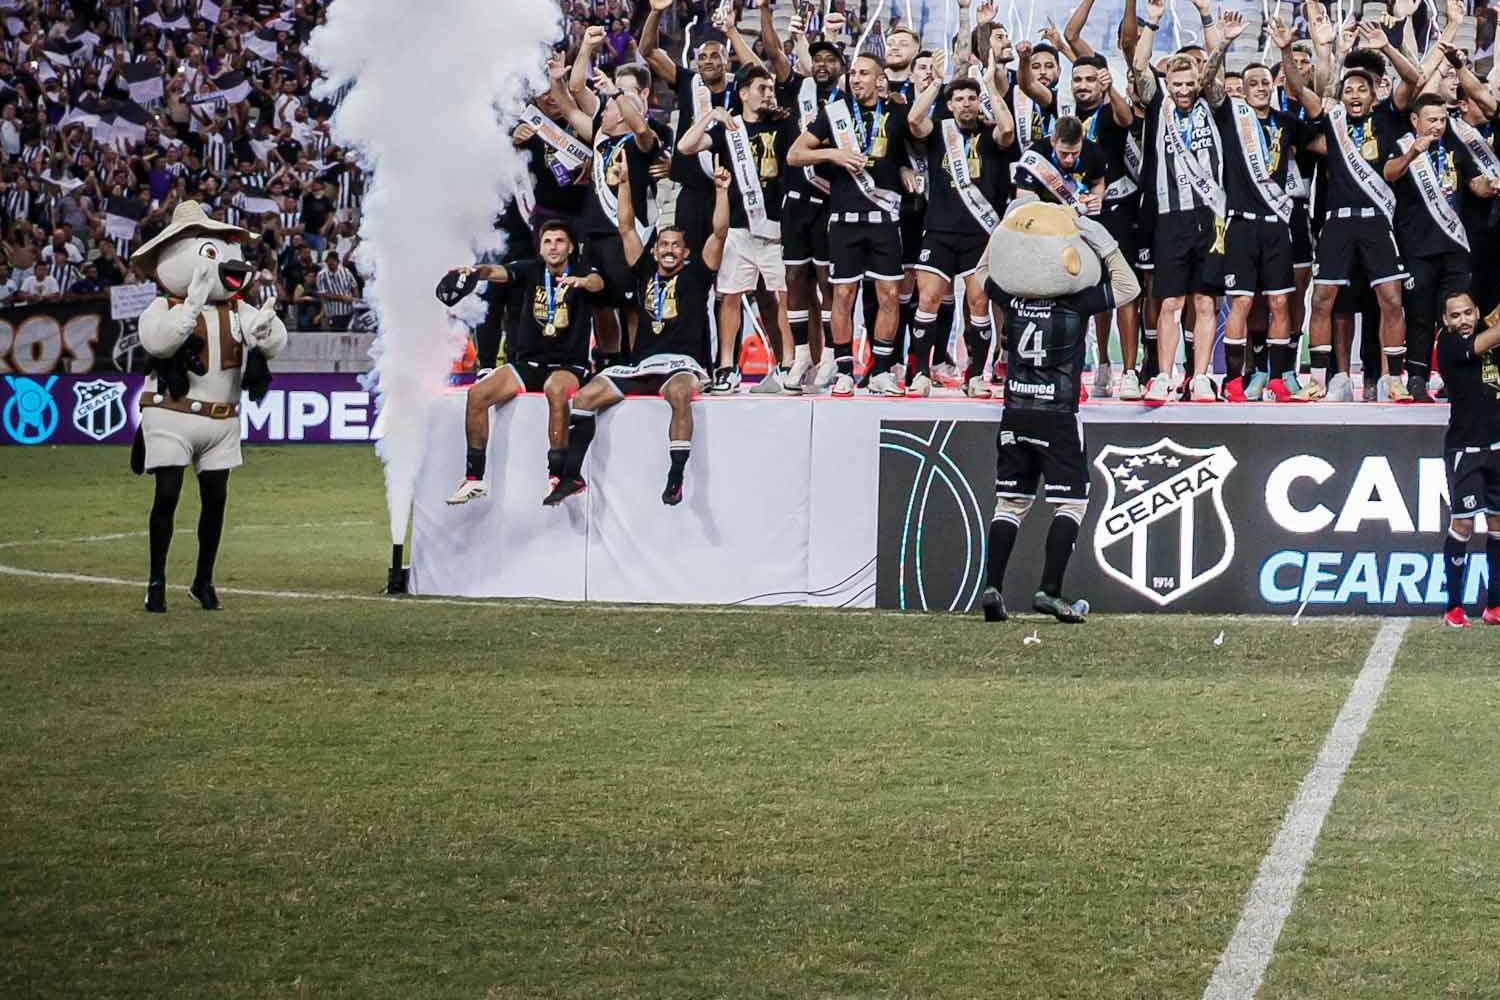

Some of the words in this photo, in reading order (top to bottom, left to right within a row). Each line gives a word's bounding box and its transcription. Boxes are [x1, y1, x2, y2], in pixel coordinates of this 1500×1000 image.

[1017, 321, 1047, 367] 4
[1008, 379, 1056, 395] Unimed
[1105, 459, 1220, 537] CEARÁ
[1151, 576, 1176, 590] 1914
